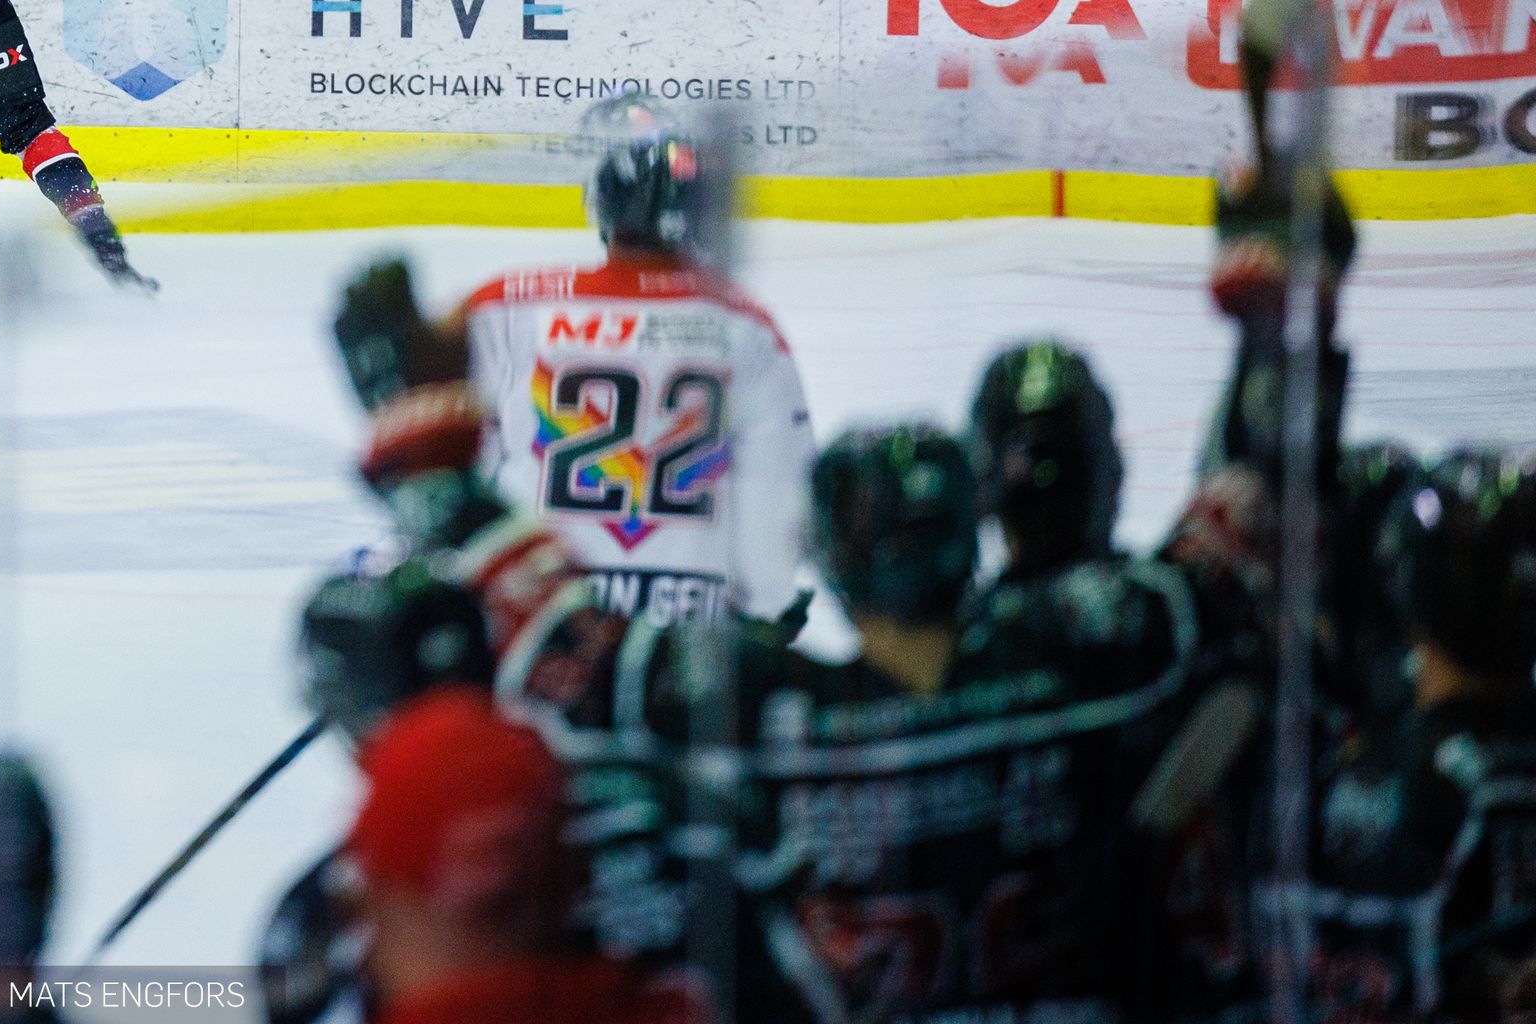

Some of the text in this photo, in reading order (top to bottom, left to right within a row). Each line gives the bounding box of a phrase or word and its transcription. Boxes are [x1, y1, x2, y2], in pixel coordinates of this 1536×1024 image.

[311, 72, 815, 101] BLOCKCHAIN TECHNOLOGIES LTD
[544, 369, 725, 516] 22
